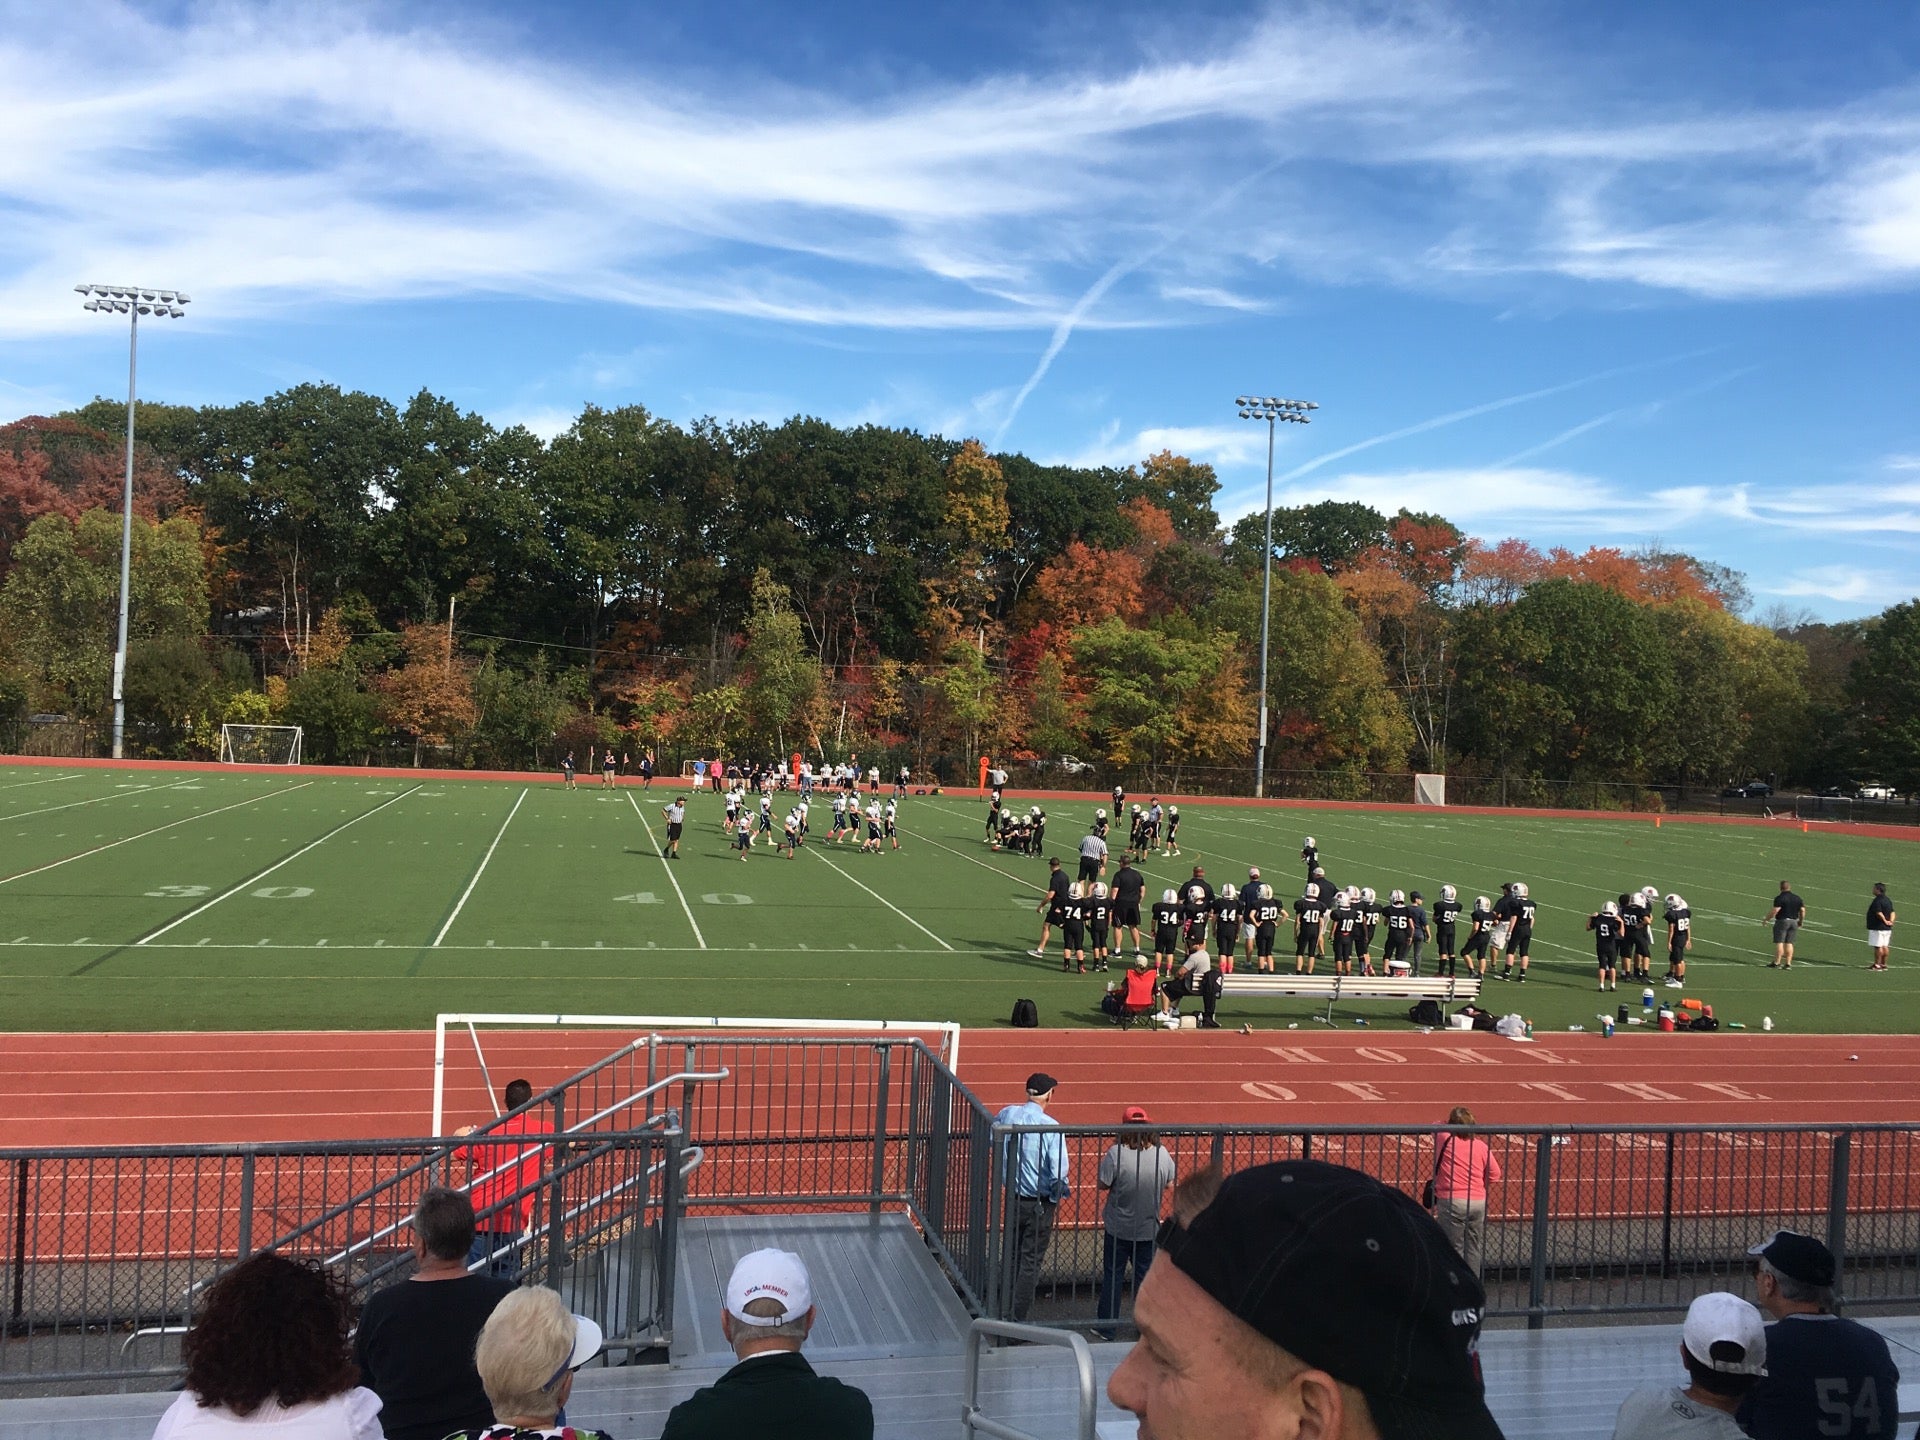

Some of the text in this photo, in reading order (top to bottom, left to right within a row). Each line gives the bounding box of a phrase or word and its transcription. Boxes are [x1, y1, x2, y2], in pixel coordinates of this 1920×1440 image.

[1064, 906, 1082, 920] 74
[1096, 906, 1106, 920] 2
[1160, 911, 1178, 925] 34
[1220, 908, 1236, 922] 44
[1261, 906, 1278, 920] 20
[1303, 909, 1320, 923] 40
[1522, 906, 1535, 919] 70
[1341, 919, 1355, 932] 10
[1390, 915, 1408, 929] 56
[1678, 917, 1690, 931] 82
[1263, 1047, 1581, 1064] HOME
[1517, 1082, 1774, 1101] THE
[762, 1284, 789, 1297] MEMBER
[1815, 1376, 1881, 1437] 54
